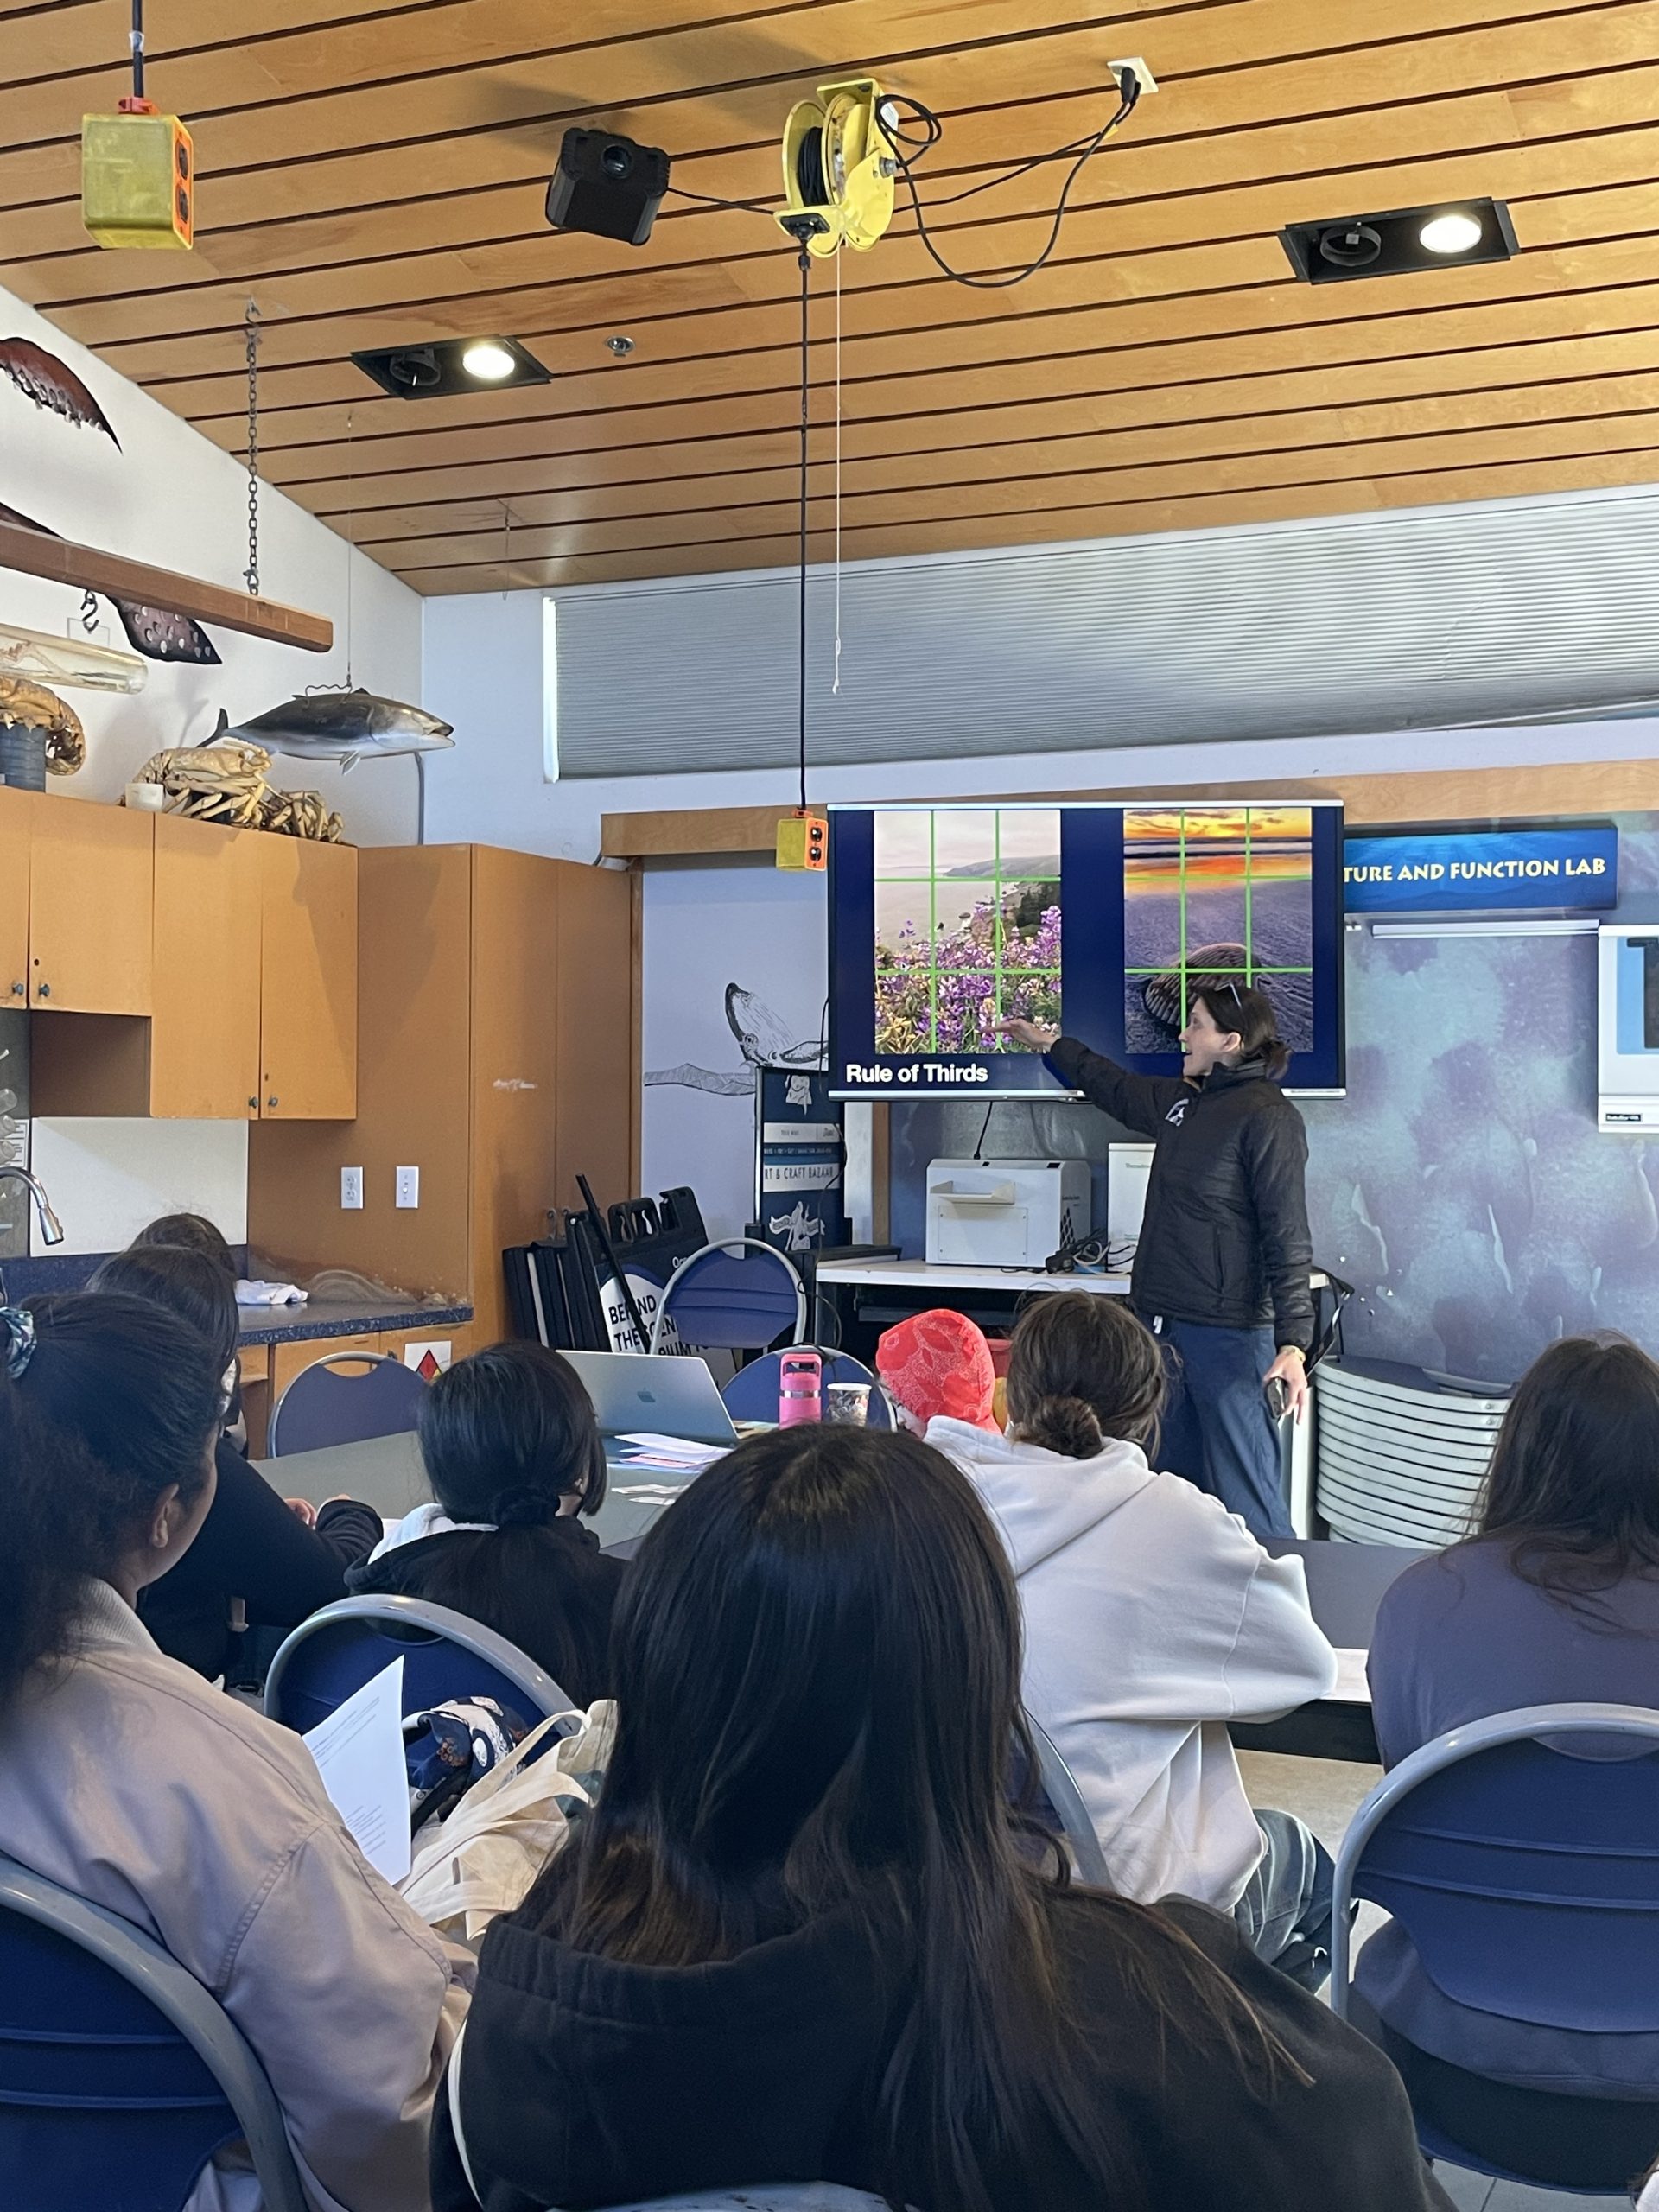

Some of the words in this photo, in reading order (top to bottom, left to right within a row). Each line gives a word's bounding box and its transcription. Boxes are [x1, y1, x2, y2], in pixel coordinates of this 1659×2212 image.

[1397, 863, 1445, 881] AND
[1450, 859, 1559, 879] FUNCTION
[1565, 858, 1605, 876] LAB
[846, 1064, 893, 1083] Rule
[897, 1064, 919, 1083] of
[923, 1063, 989, 1083] Thirds
[784, 1166, 805, 1179] CRAFT
[809, 1166, 833, 1179] BAZAAR
[608, 1294, 657, 1325] BEND
[614, 1327, 641, 1351] THE
